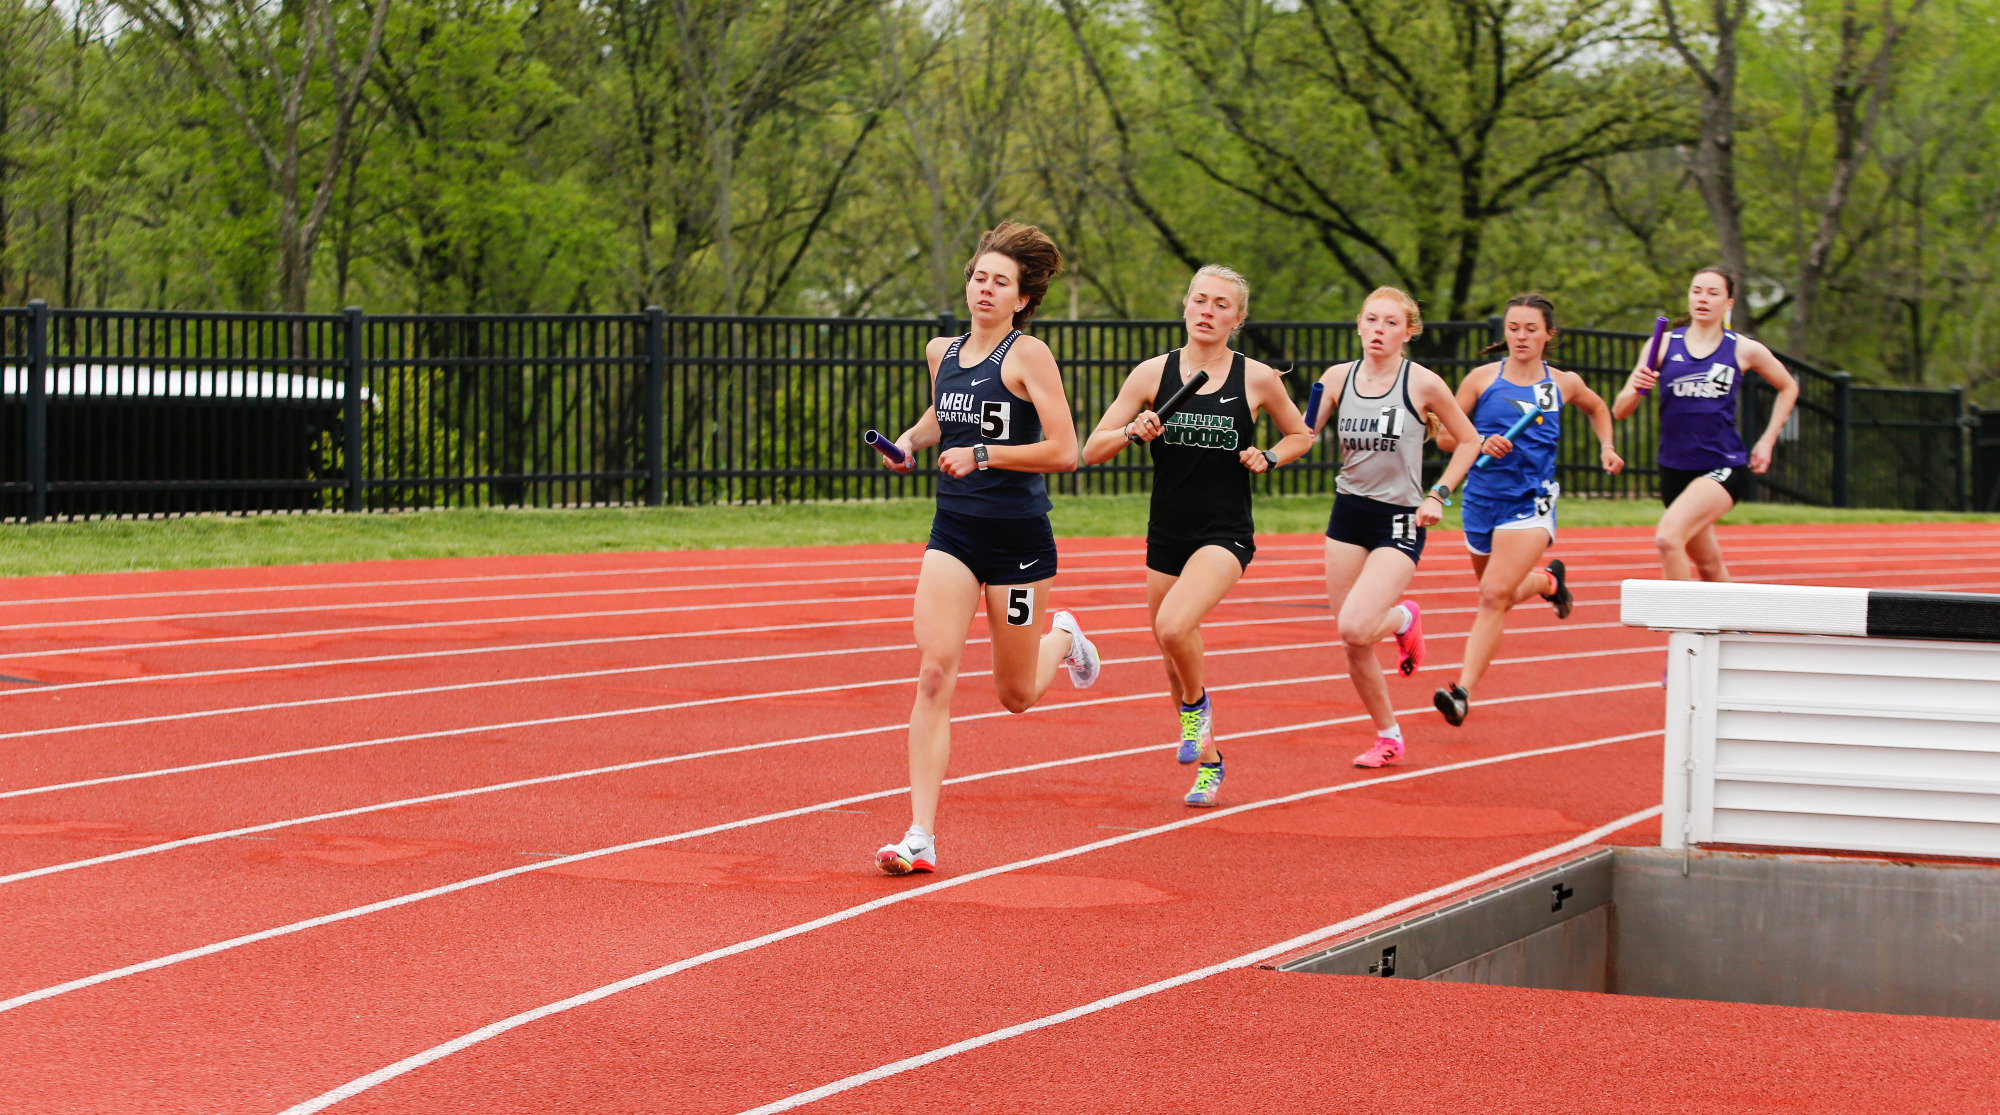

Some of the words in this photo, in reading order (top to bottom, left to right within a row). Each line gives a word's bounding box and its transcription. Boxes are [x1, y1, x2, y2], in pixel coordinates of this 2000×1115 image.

[1712, 366, 1729, 393] 4
[939, 392, 975, 411] MBU
[1539, 382, 1553, 410] 3
[936, 410, 981, 424] SPARTANS
[981, 402, 1004, 439] 5
[1339, 417, 1404, 433] COLUM
[1381, 408, 1401, 440] 1
[1163, 423, 1239, 451] WOODS
[1343, 437, 1397, 452] COLLEGE
[1394, 514, 1416, 543] 1
[1007, 588, 1030, 626] 5
